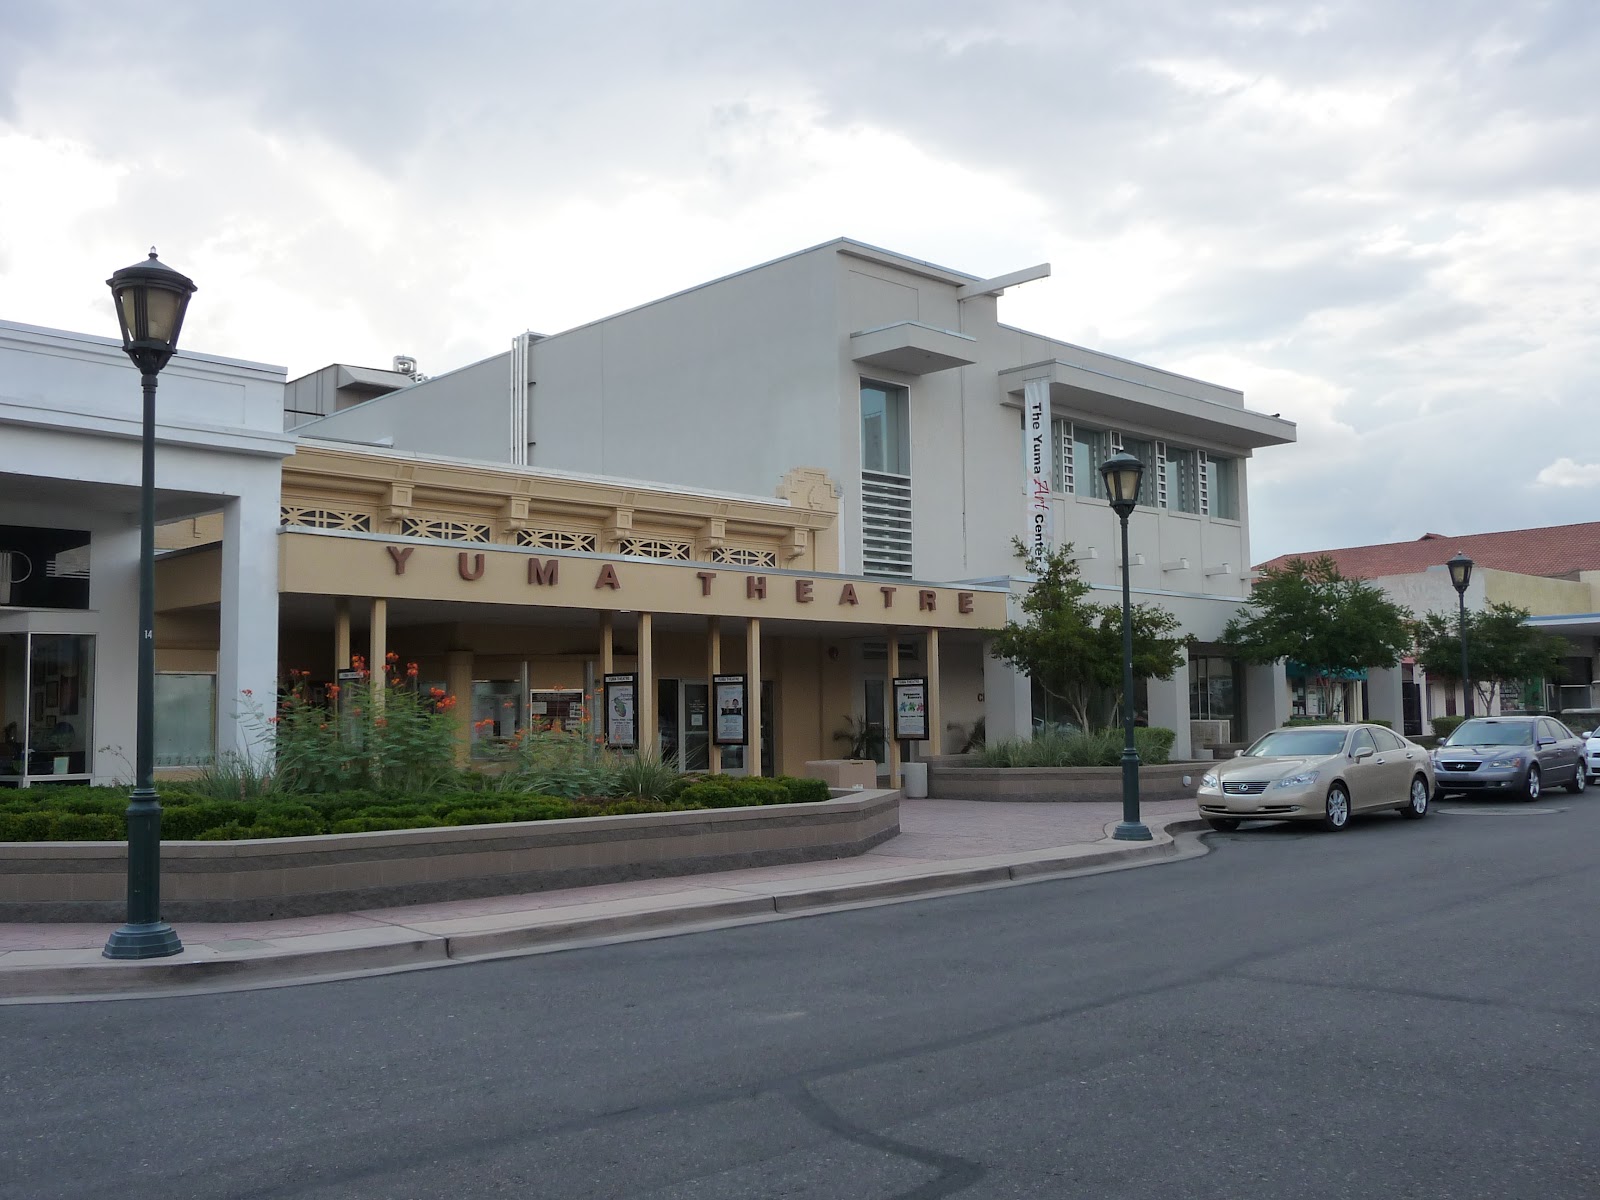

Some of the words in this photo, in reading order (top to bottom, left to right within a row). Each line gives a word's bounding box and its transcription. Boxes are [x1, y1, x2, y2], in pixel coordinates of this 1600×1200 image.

[1032, 402, 1042, 430] The
[1033, 433, 1043, 475] Yuma
[1034, 479, 1050, 511] Art
[1035, 514, 1044, 562] Center
[386, 546, 621, 590] YUMA
[697, 571, 974, 614] THEATRE
[144, 629, 153, 640] 14
